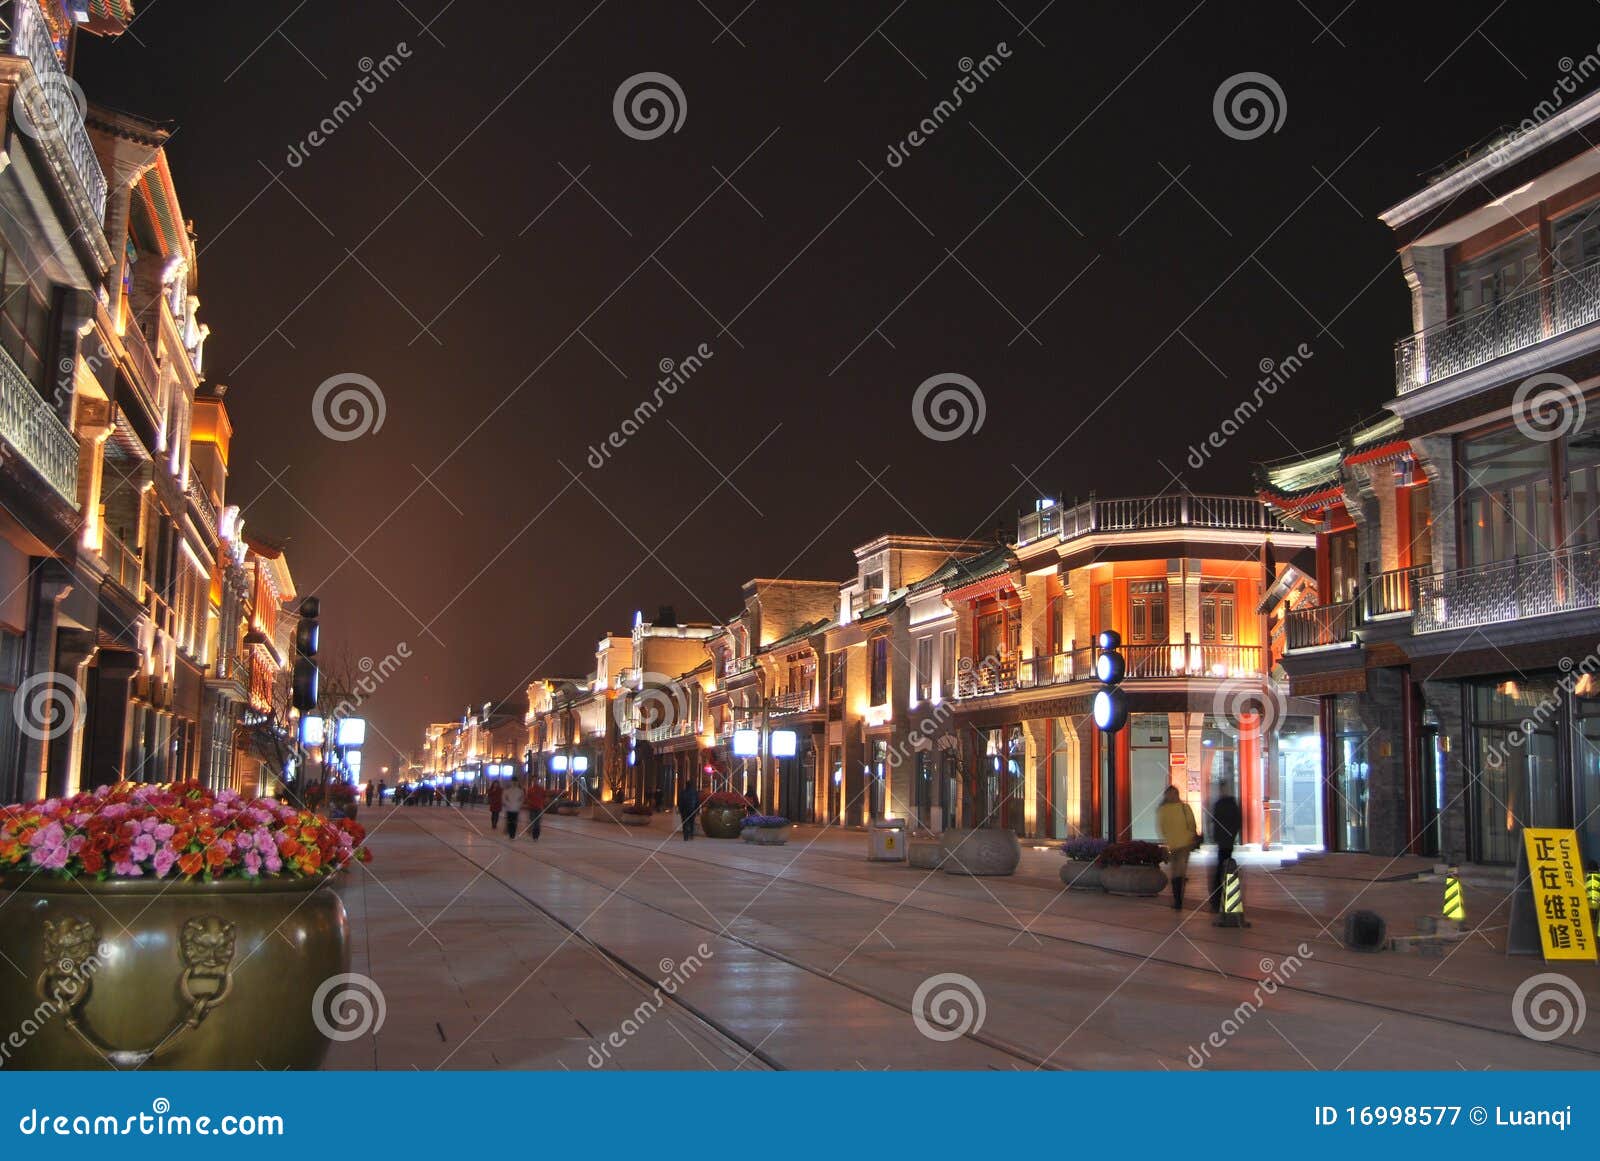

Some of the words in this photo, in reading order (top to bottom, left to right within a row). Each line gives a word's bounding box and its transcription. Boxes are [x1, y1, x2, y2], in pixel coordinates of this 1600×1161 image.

[1533, 836, 1572, 950] 正在维修
[1558, 837, 1575, 888] Under
[1568, 895, 1587, 951] Repair
